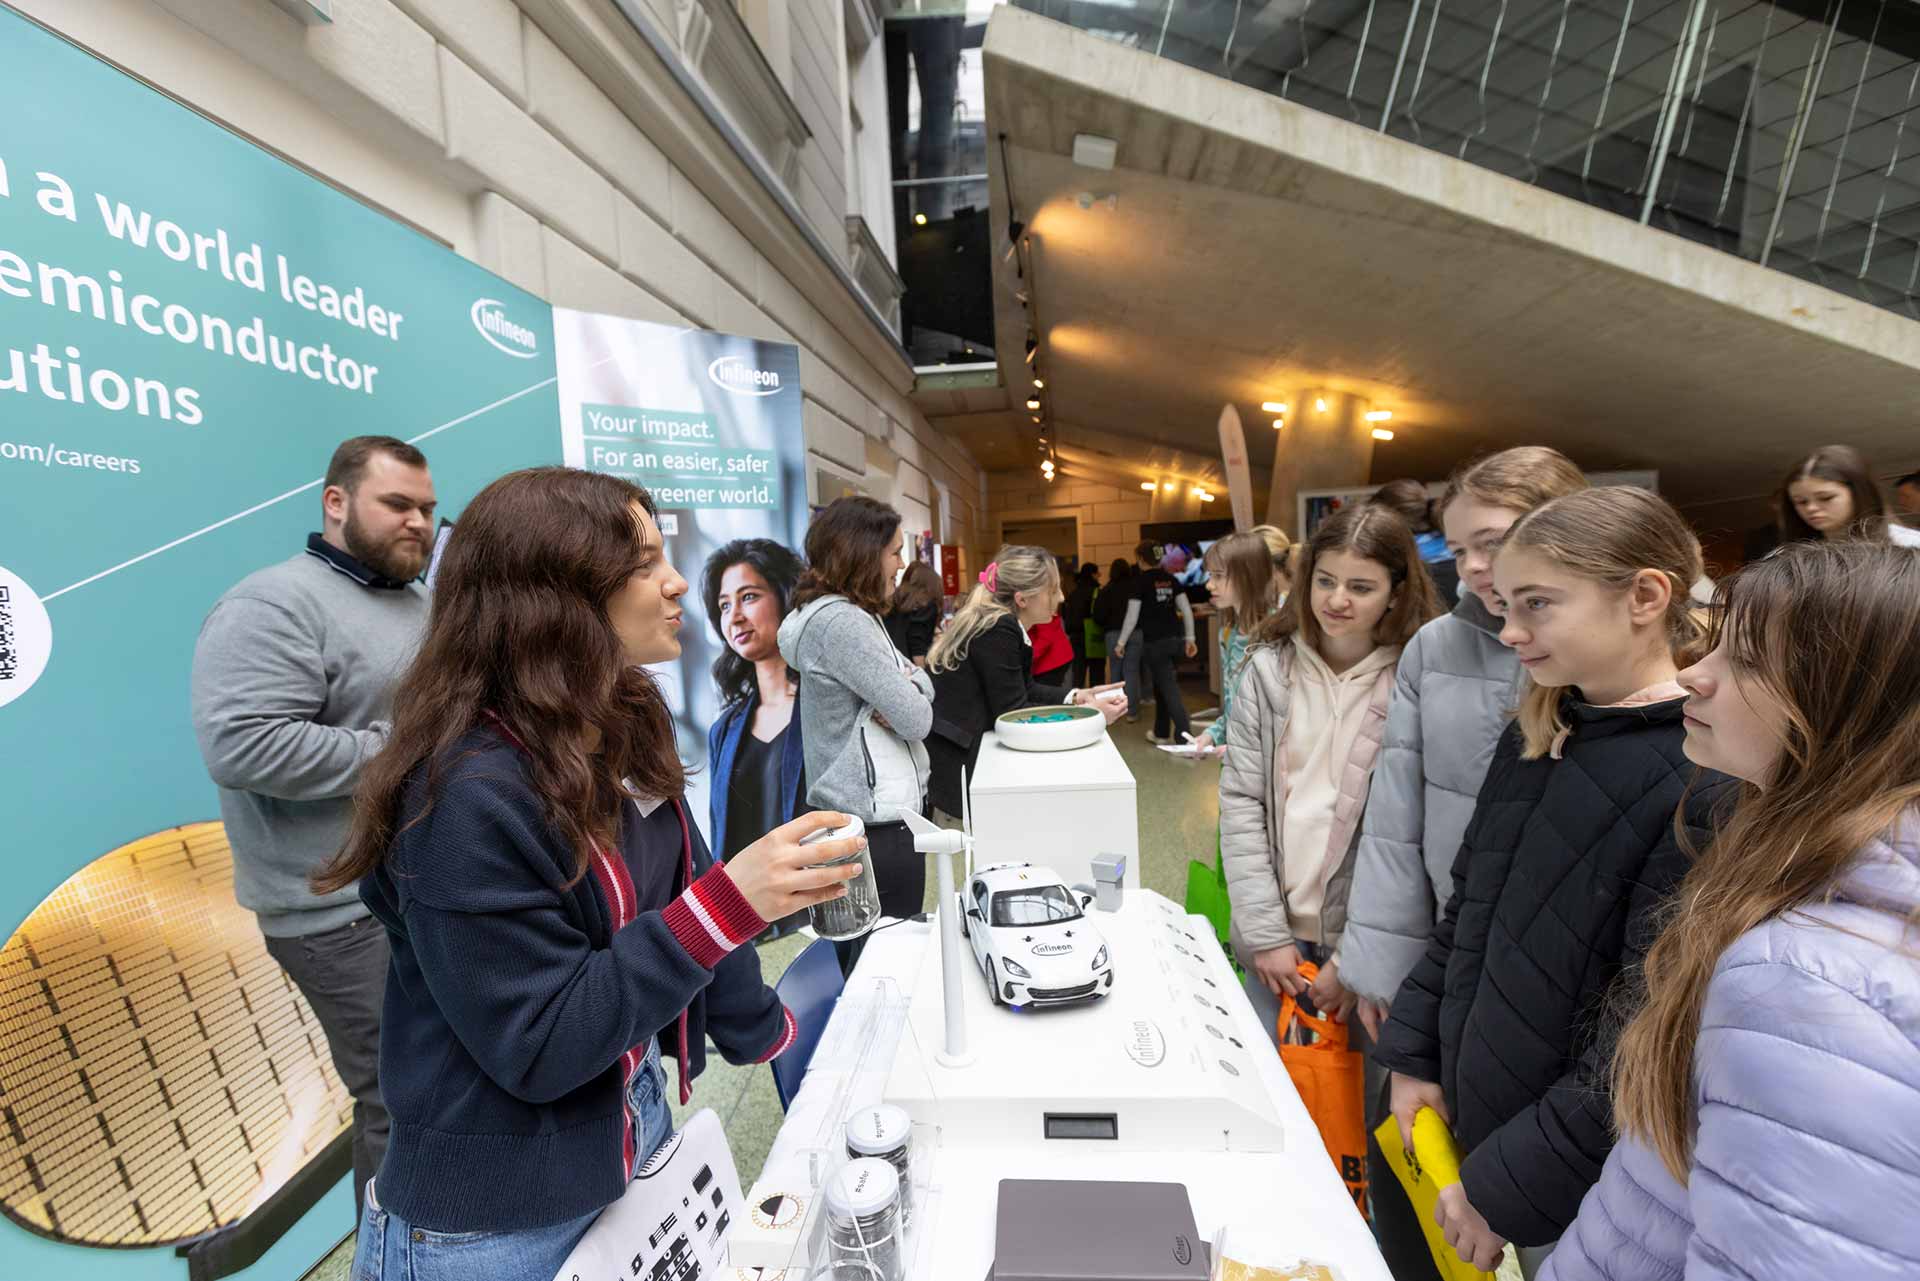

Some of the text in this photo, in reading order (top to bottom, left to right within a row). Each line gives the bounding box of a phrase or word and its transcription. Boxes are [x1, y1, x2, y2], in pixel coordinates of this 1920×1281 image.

[36, 171, 78, 223] a
[95, 191, 265, 292] world
[277, 255, 404, 341] leader
[587, 411, 715, 439] Your impact.
[592, 447, 768, 475] For an easier, safer
[719, 486, 774, 504] world.
